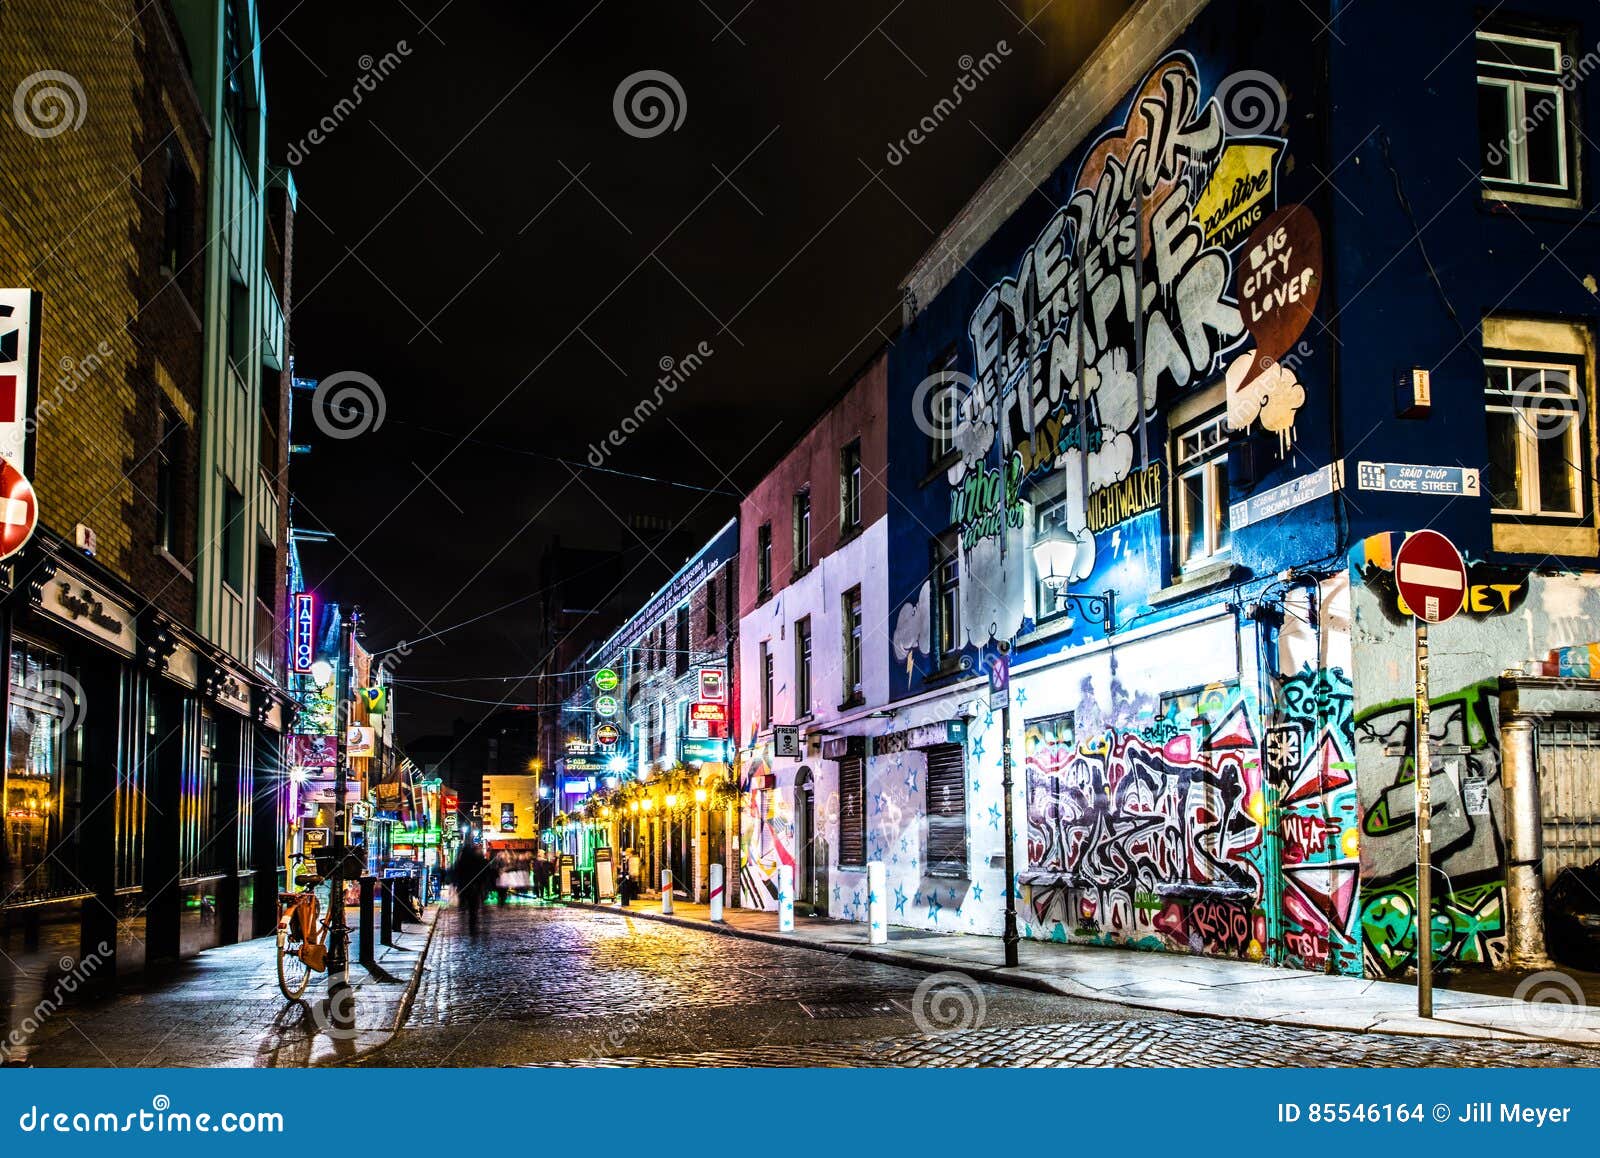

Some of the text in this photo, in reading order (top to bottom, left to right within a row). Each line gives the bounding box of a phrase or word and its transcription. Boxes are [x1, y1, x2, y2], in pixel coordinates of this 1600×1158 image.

[1204, 169, 1269, 233] positive
[1211, 205, 1262, 247] LIVING
[1250, 226, 1287, 270] BIG
[970, 213, 1071, 376] EYE
[1243, 247, 1293, 298] CITY
[1251, 267, 1314, 322] LOVER
[1000, 183, 1199, 456] TEMPLE
[1389, 479, 1458, 492] COPE STREET
[1425, 468, 1448, 479] CHÓP
[1467, 475, 1477, 489] 2
[1088, 463, 1161, 531] NIGHTWALKER
[1261, 488, 1316, 516] CROWN ALLEY
[962, 502, 1024, 551] achieer
[298, 597, 311, 668] TATTOO
[693, 712, 724, 720] GARDEN
[698, 705, 718, 713] BEER
